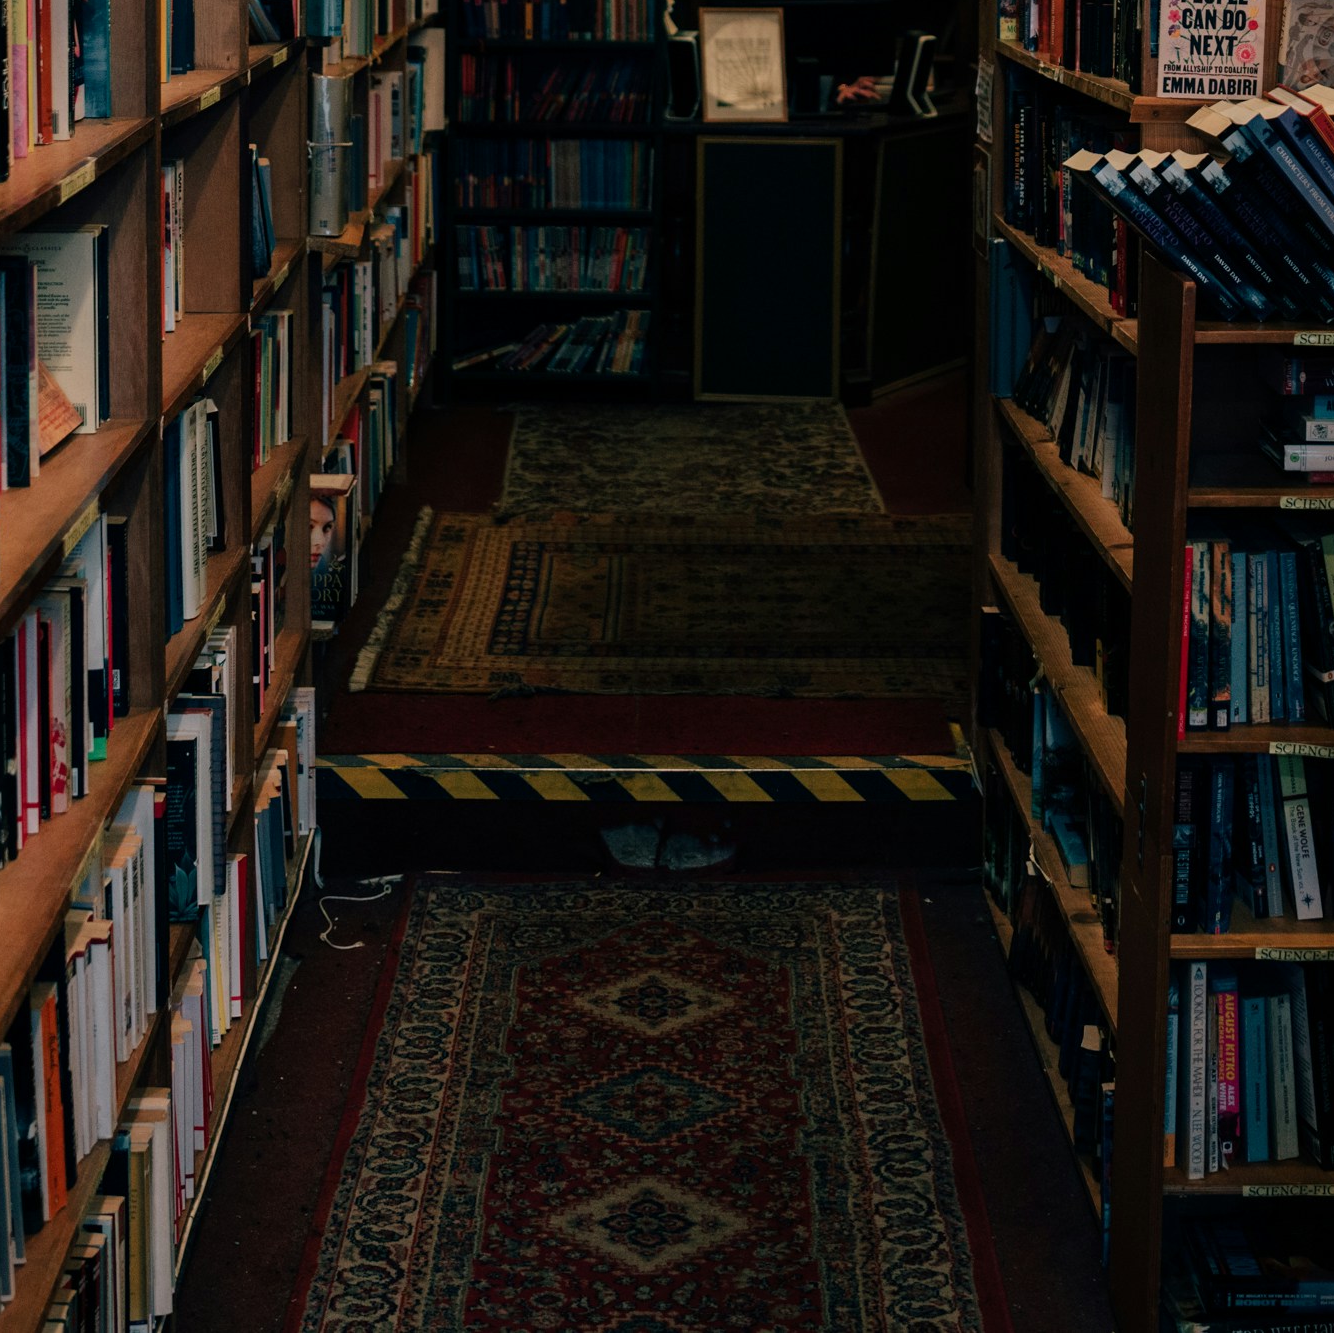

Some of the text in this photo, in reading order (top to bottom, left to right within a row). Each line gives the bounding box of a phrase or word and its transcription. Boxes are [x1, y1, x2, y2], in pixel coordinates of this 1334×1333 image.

[1181, 9, 1247, 31] CAN DO
[1189, 35, 1238, 57] NEXT
[1163, 64, 1258, 75] FROM ALLYSHIP TO COALITION
[1162, 77, 1258, 96] EMMA DABIRI
[1275, 146, 1309, 190] CHARACTERS
[1295, 805, 1310, 859] GENE WOLFE
[1225, 994, 1237, 1106] AUGUST KITKO ALEX
[1191, 983, 1205, 1164] LOOKING FOR THE MAHDI WOOD
[1218, 1082, 1227, 1111] WHITE
